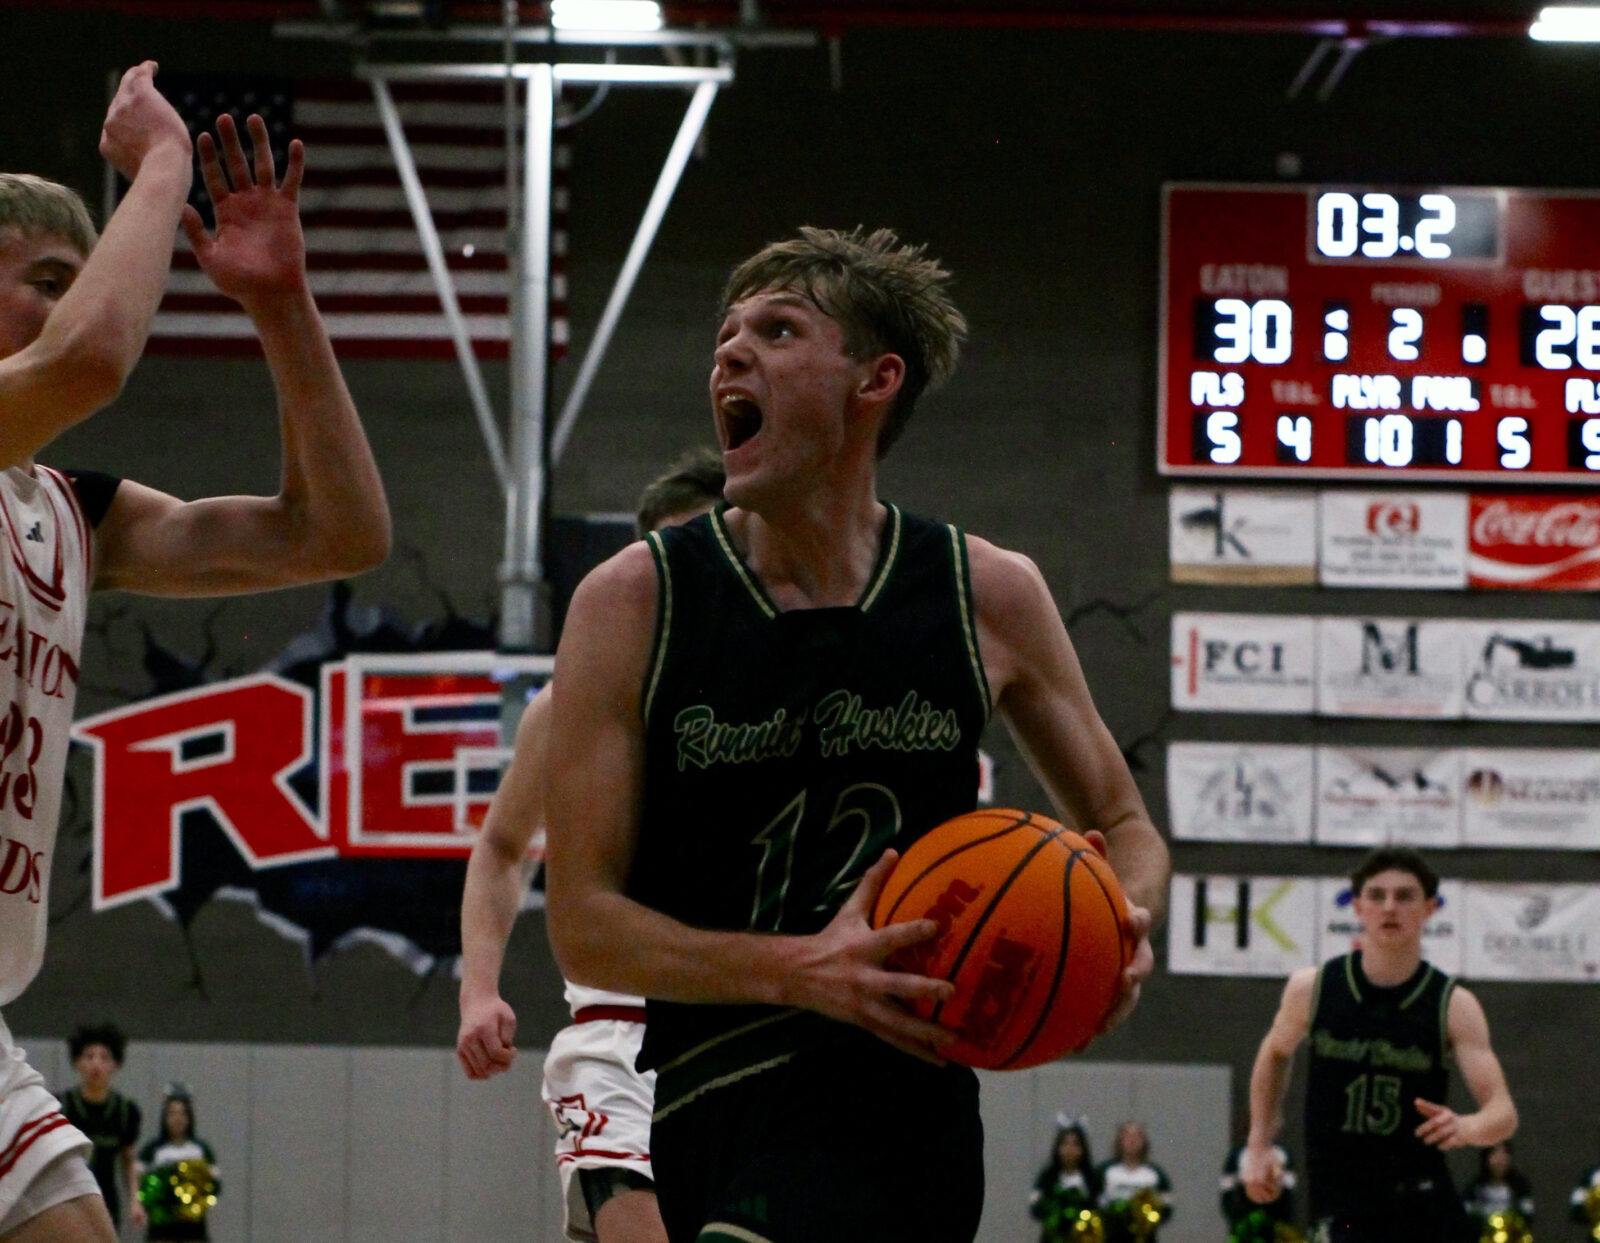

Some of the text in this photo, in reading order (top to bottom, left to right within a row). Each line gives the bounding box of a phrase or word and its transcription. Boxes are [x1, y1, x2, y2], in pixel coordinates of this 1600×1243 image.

[1317, 193, 1456, 258] 03.2
[1200, 263, 1289, 294] EATON
[1522, 267, 1600, 301] GUES
[1214, 299, 1292, 364] 30
[1388, 308, 1423, 361] 2
[1206, 411, 1242, 464] 5
[1276, 416, 1312, 462] 4
[1364, 414, 1413, 467] 10
[1497, 416, 1531, 469] 5
[749, 780, 904, 932] 12
[1340, 1072, 1403, 1136] 15
